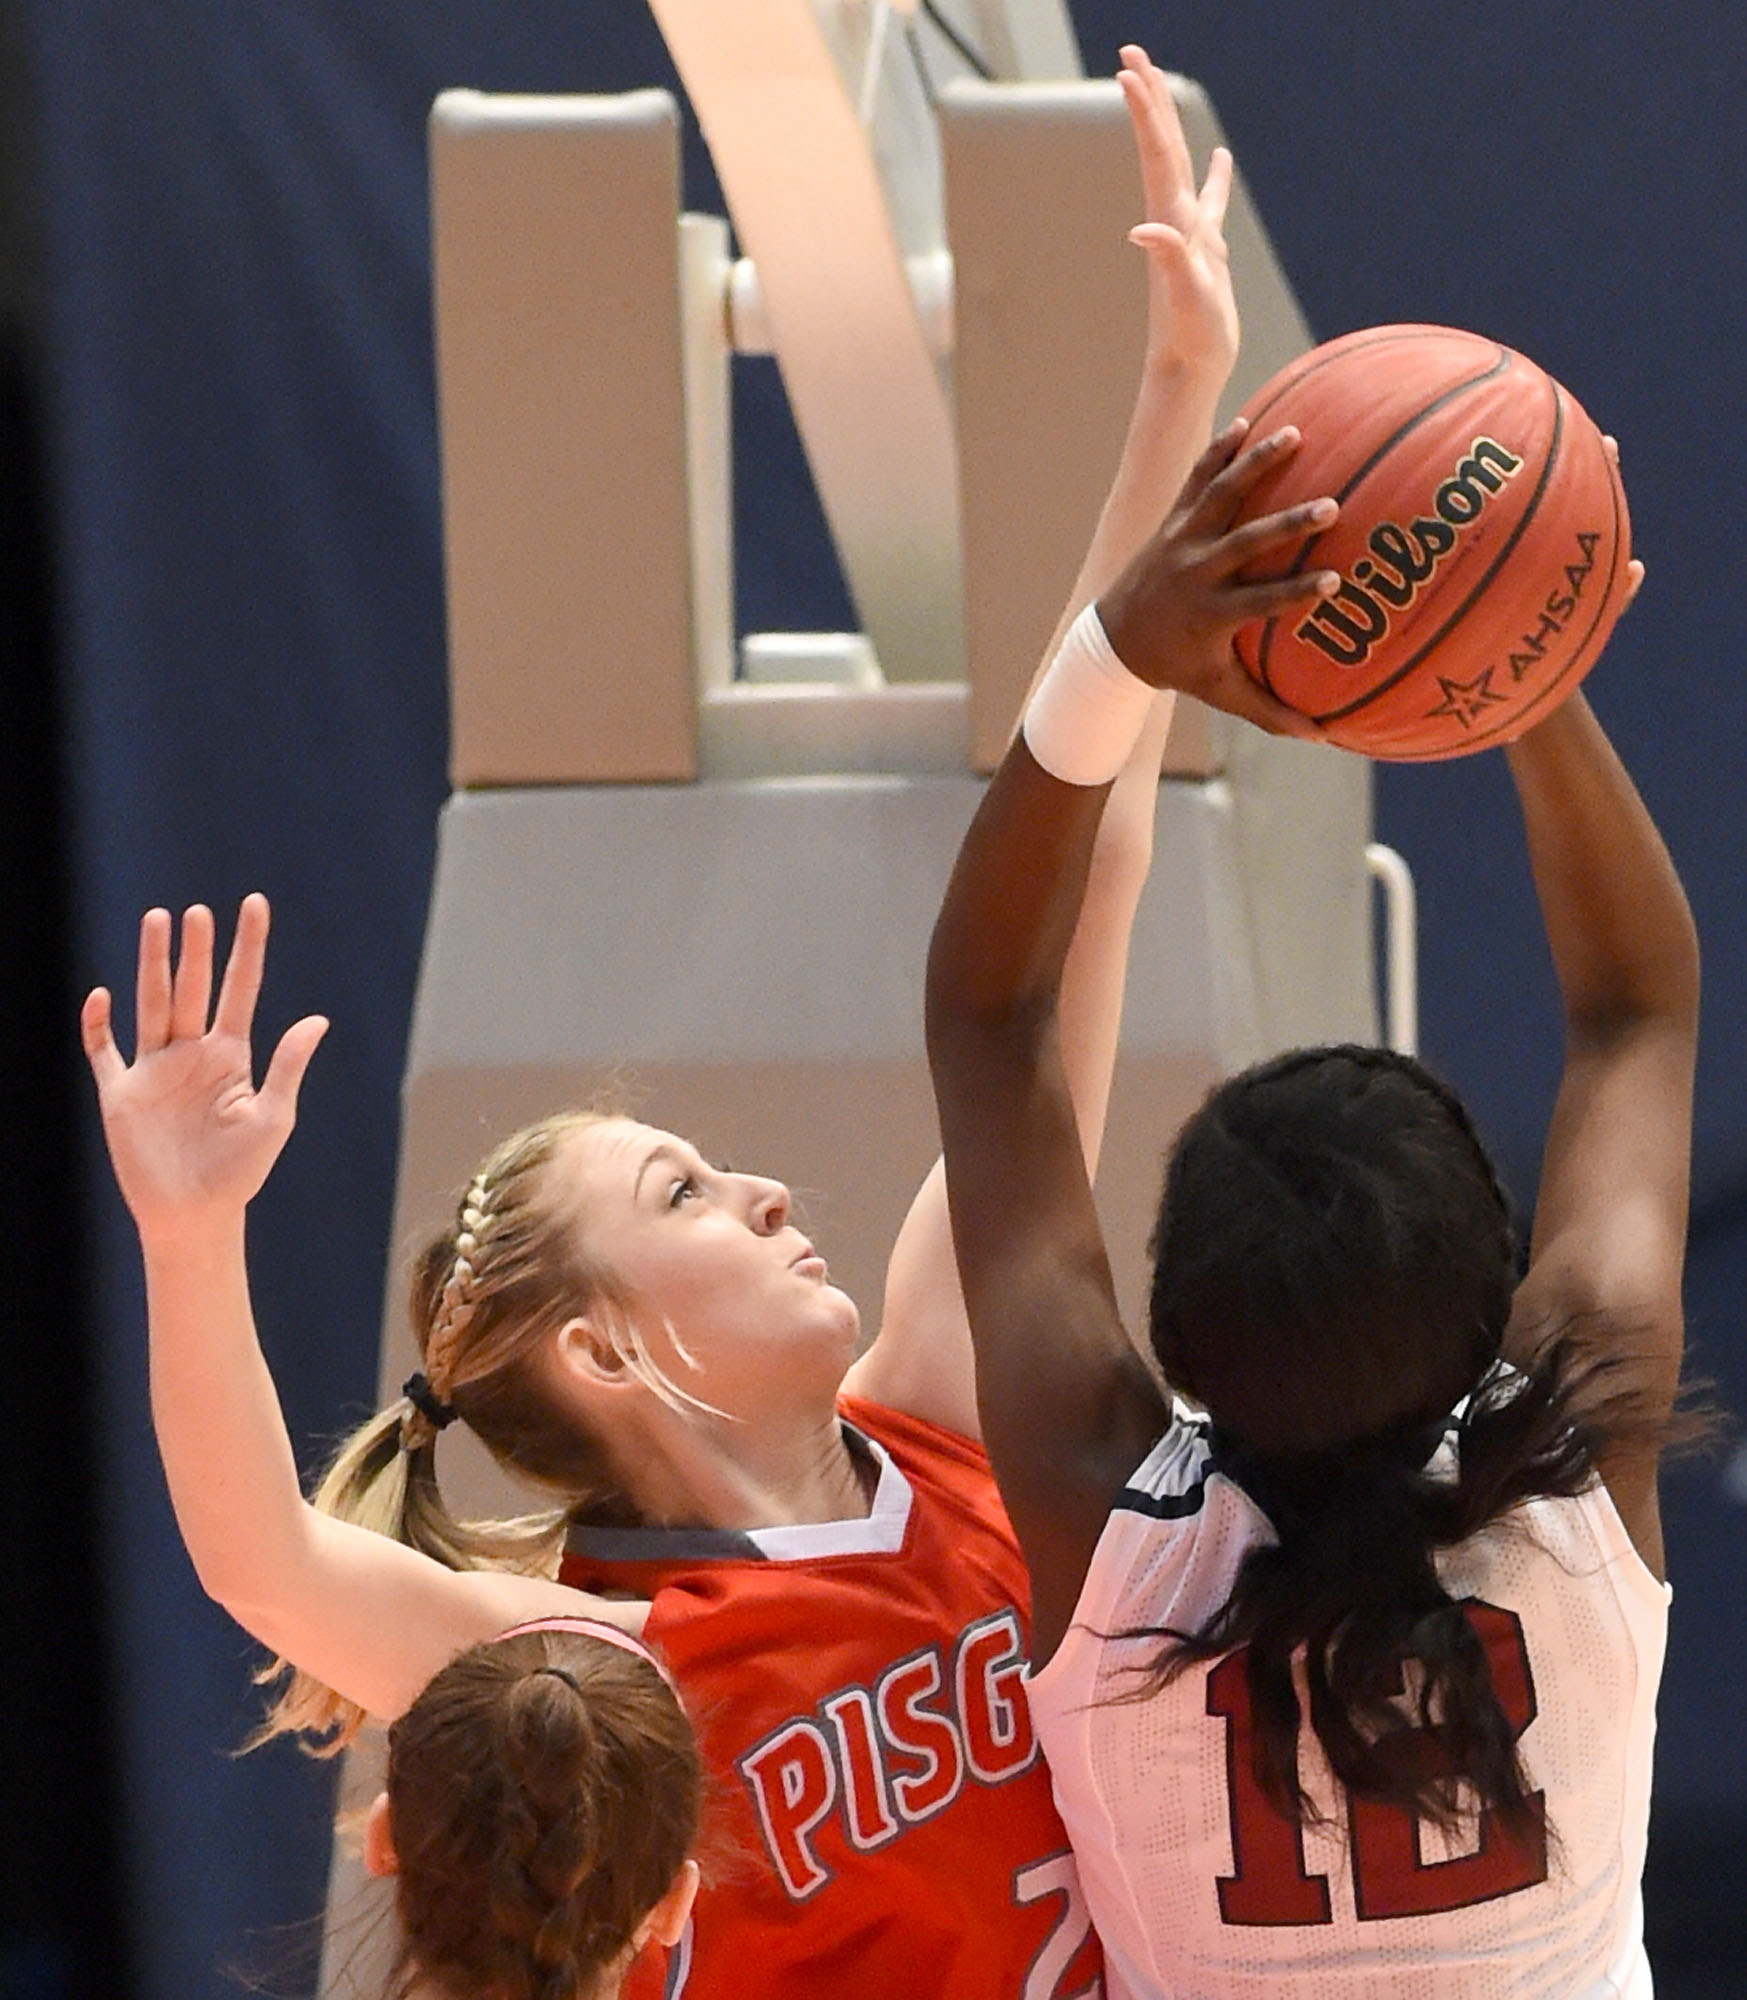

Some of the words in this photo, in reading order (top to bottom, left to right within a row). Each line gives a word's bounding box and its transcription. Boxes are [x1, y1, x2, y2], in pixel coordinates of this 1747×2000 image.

[1294, 436, 1525, 669] Wilson
[1508, 531, 1602, 681] AHSAA
[1206, 1597, 1548, 1926] 12
